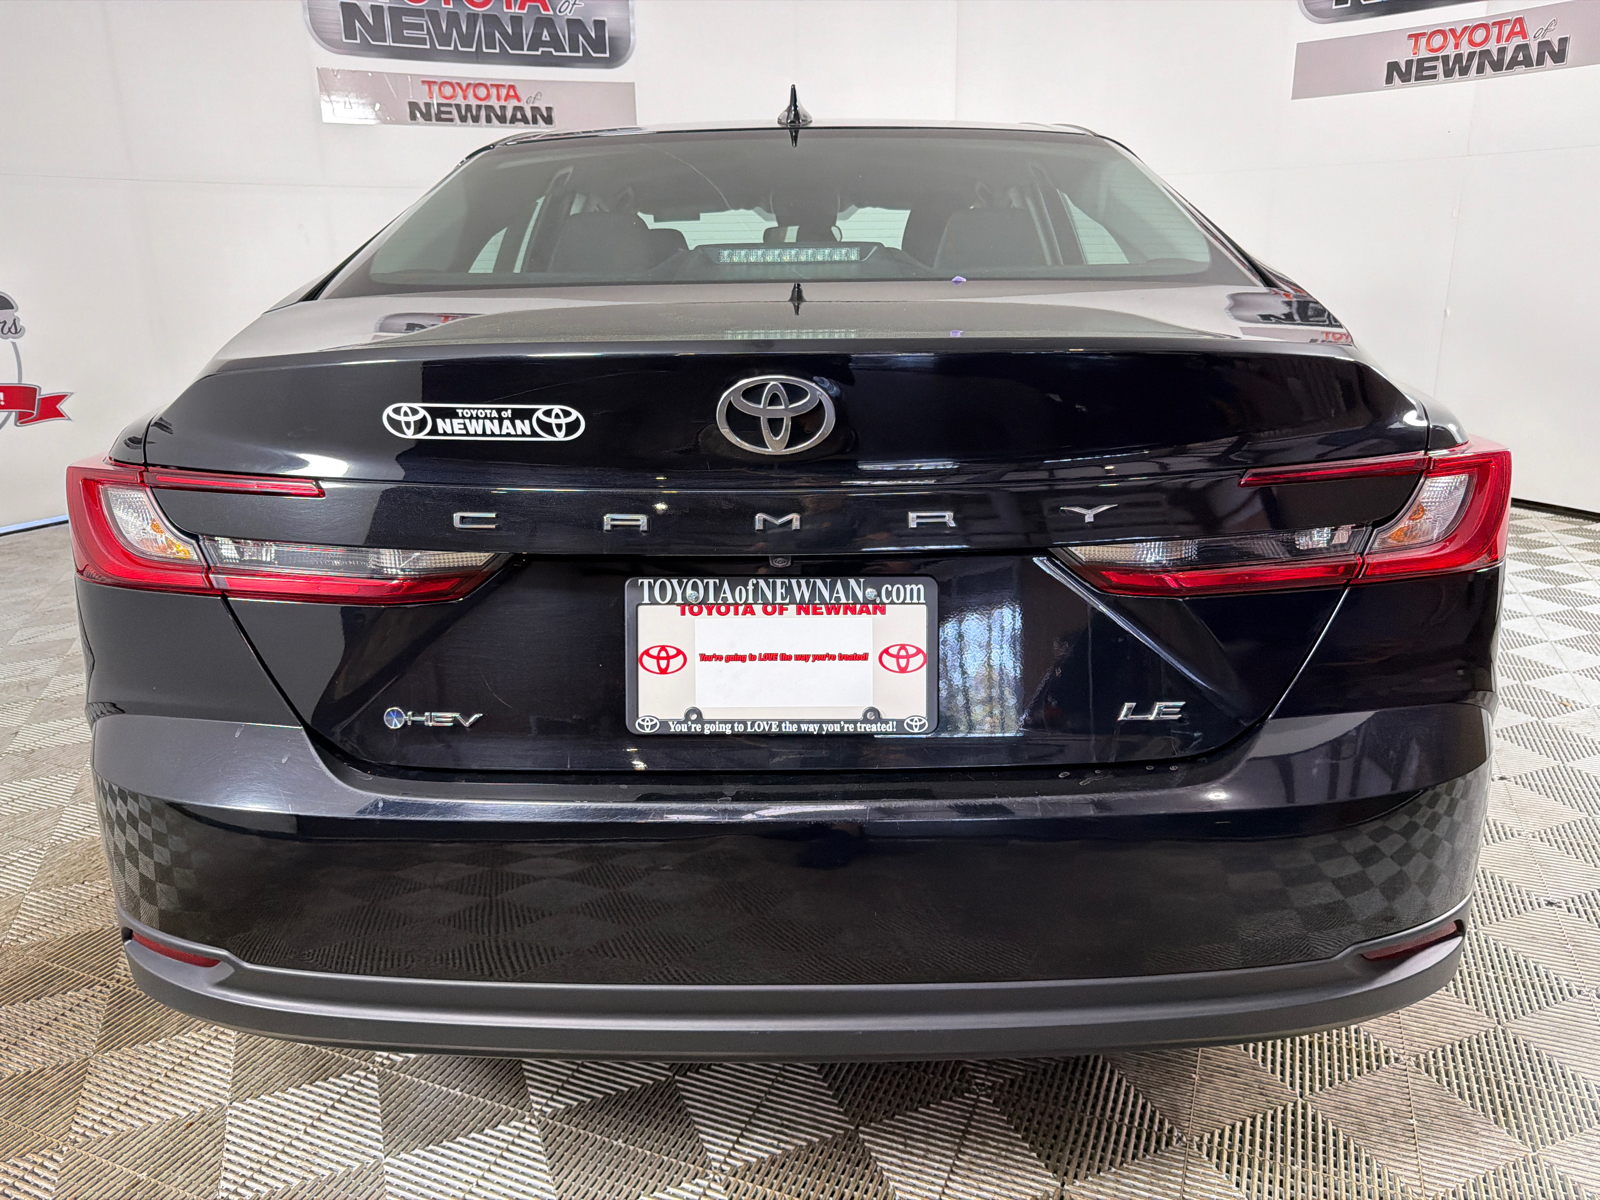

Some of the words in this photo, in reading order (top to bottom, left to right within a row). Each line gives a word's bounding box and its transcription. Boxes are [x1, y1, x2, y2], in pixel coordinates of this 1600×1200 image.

[341, 2, 610, 57] NEWNAN
[1407, 16, 1529, 56] TOYOTA
[1533, 18, 1557, 40] of
[1384, 36, 1570, 86] NEWNAN
[421, 80, 522, 103] TOYOTA
[408, 101, 555, 126] NEWNAN
[456, 409, 498, 418] TOYOTA
[501, 409, 512, 418] of
[436, 418, 532, 436] NEWNAN
[638, 578, 926, 604] TOYOTAofNEWNAN.com
[676, 604, 756, 616] TOYOTA
[762, 604, 789, 616] OF
[796, 604, 887, 616] NEWNAN
[699, 652, 724, 662] You're
[724, 652, 747, 663] going
[748, 652, 757, 662] to
[758, 652, 779, 662] LOVE
[779, 652, 793, 662] the
[794, 653, 811, 663] way
[811, 652, 837, 663] you're
[838, 652, 869, 662] treated!
[1117, 701, 1186, 721] LE
[668, 721, 702, 732] You're
[703, 721, 732, 735] going
[734, 722, 745, 732] to
[746, 721, 780, 732] LOVE
[781, 721, 798, 732] the
[800, 723, 820, 735] way
[821, 721, 855, 735] you're
[856, 721, 897, 732] treated!
